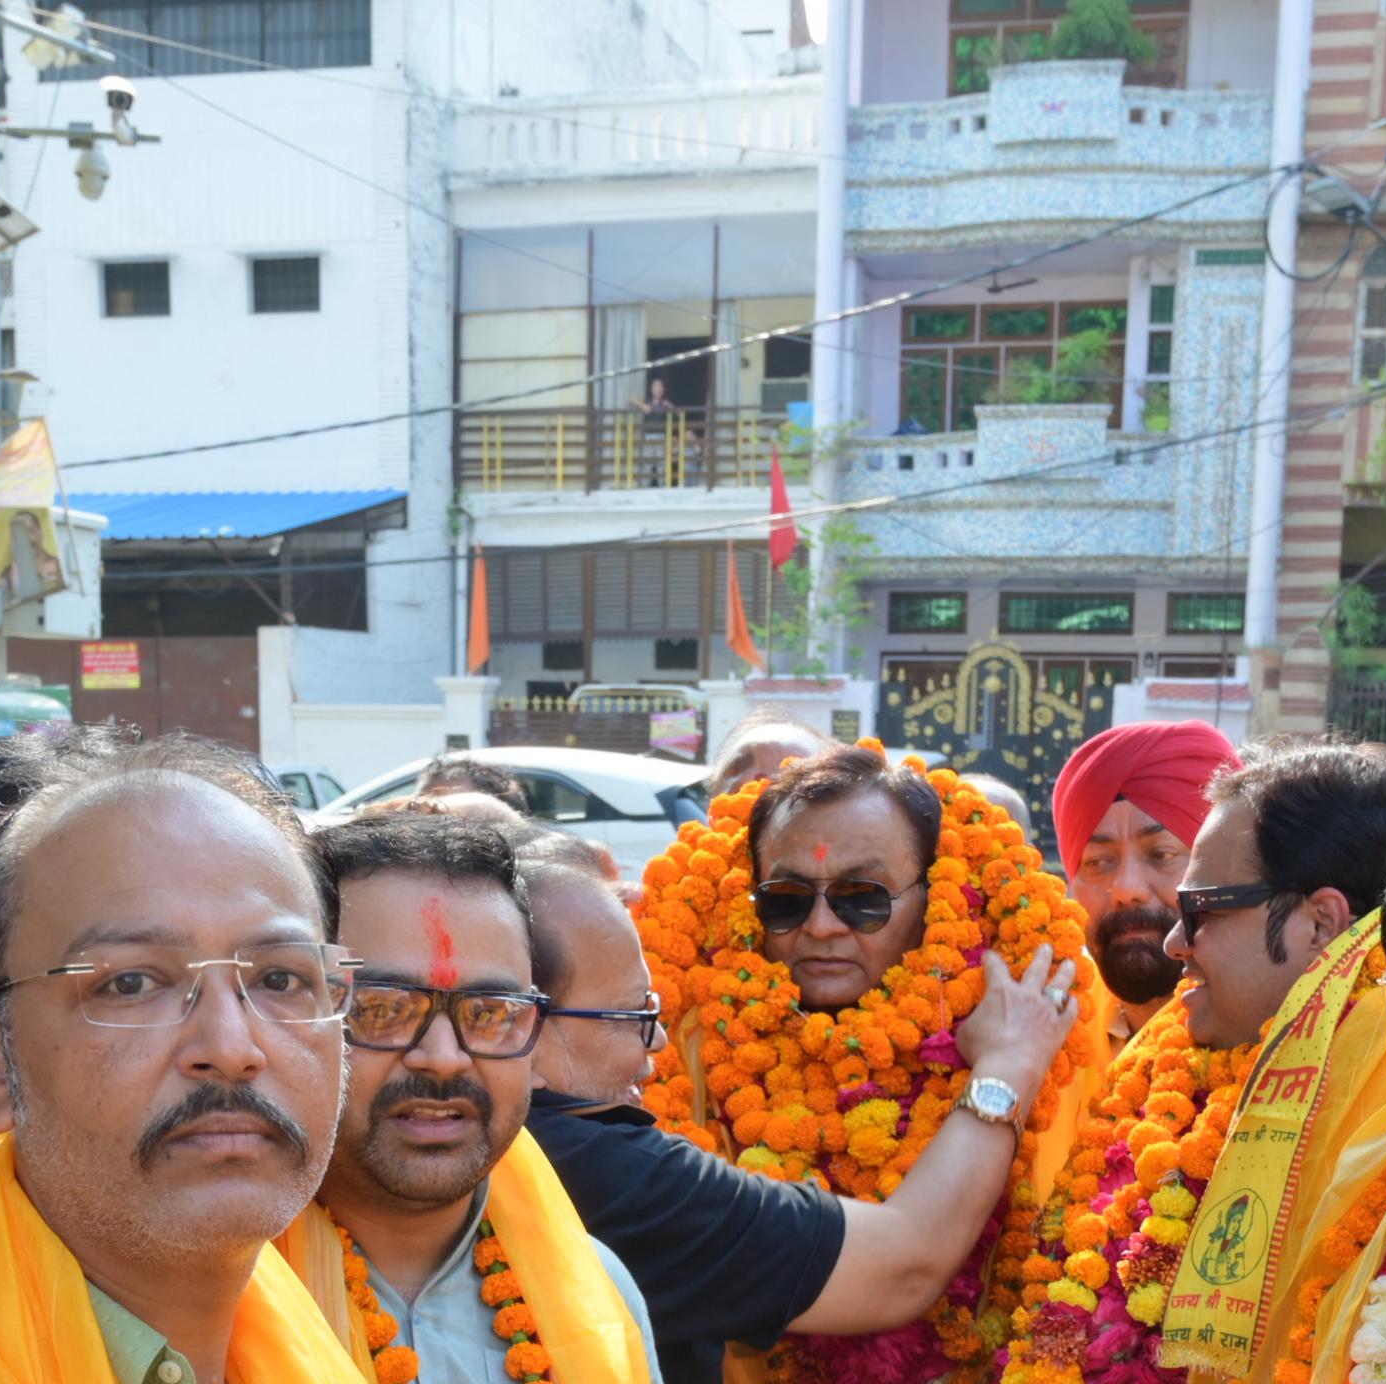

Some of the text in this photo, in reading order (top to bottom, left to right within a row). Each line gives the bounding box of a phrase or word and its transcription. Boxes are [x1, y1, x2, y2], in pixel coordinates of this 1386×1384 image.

[1270, 1129, 1297, 1144] राम
[1171, 1288, 1256, 1317] जय श्री राम
[1197, 1322, 1215, 1344] श्री
[1220, 1330, 1249, 1350] राम
